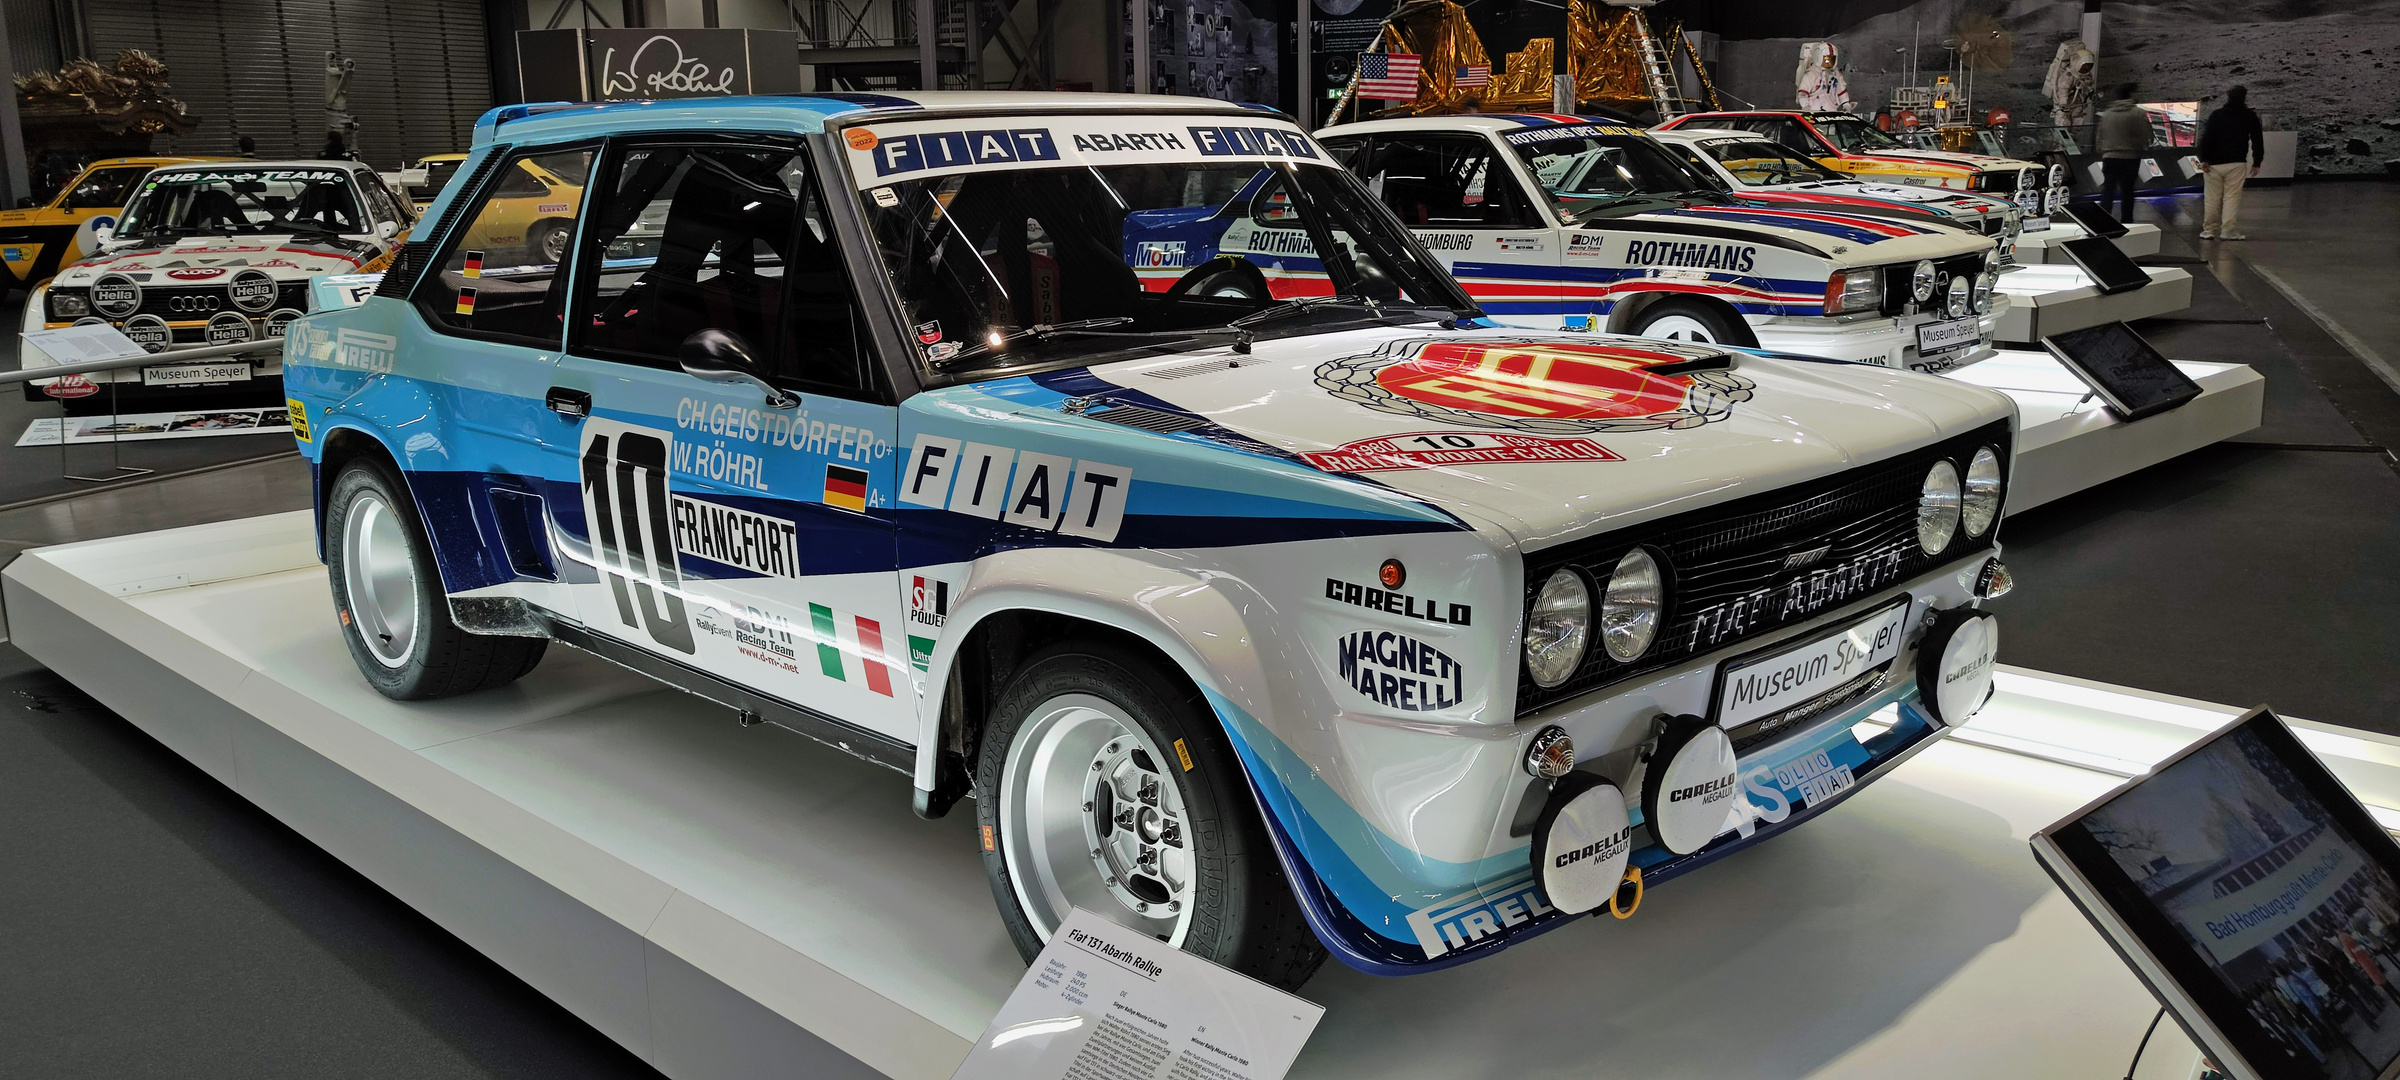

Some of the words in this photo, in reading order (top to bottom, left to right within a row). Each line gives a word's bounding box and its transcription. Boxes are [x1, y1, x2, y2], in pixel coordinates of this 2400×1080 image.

[1505, 127, 1575, 145] ROTHMANS
[1571, 126, 1602, 137] OPEL
[883, 132, 1043, 170] FIAT
[1073, 132, 1187, 152] ABARTH
[1196, 129, 1308, 156] FIAT
[157, 173, 200, 184] HB
[263, 171, 336, 182] TEAM
[1903, 177, 1926, 186] Castrol
[490, 235, 521, 244] BOSCH
[1248, 230, 1315, 254] ROTHMA
[1581, 236, 1604, 246] DMI
[1136, 241, 1185, 267] Mobil
[1625, 240, 1756, 273] ROTHMANS
[98, 291, 132, 301] Hella
[236, 286, 270, 297] Hella
[129, 332, 163, 343] Hella
[213, 328, 246, 340] Hella
[1923, 326, 1956, 343] Museum
[1956, 322, 1976, 340] Speyer
[335, 327, 397, 374] PIRELLI
[149, 368, 200, 380] Museum
[204, 366, 245, 380] Speyer
[1351, 440, 1398, 457] 1980
[1412, 434, 1476, 450] 10
[1494, 435, 1551, 448] 1980
[1427, 442, 1604, 463] MONTE-CARLO
[868, 488, 886, 509] A+
[912, 443, 1119, 529] FIAT
[582, 431, 696, 656] 10
[673, 498, 797, 579] FRANCFORT
[1784, 547, 1831, 569] FIAT
[1325, 577, 1471, 626] CARELLO
[695, 617, 733, 640] RallyEvent
[736, 629, 767, 650] Racing
[769, 639, 795, 658] Team
[1338, 630, 1462, 680] MAGNETI
[1945, 652, 1988, 684] CARELLO
[1338, 666, 1463, 712] MARELLI
[1731, 653, 1829, 711] Museum
[1758, 717, 1778, 732] Auto
[1783, 701, 1821, 722] Manger
[1778, 752, 1829, 787] OLIO
[1670, 772, 1735, 803] CARELLO
[1702, 786, 1734, 806] MEGALUX
[1803, 767, 1852, 803] FIAT
[1555, 825, 1630, 869] CARELLO
[1593, 840, 1630, 866] MEGALUX
[1405, 868, 1555, 961] PIREL
[2205, 912, 2239, 940] Bad
[2229, 897, 2288, 931] Homburg
[2279, 880, 2309, 911] grüßt
[1068, 928, 1087, 943] Fiat
[1086, 937, 1103, 949] 131
[1100, 943, 1134, 963] Abarth
[1131, 957, 1163, 978] Rallye
[1069, 977, 1080, 985] 240
[1074, 970, 1087, 979] 1980
[1064, 984, 1080, 994] 2.000
[1112, 1001, 1125, 1010] Sieger
[1123, 1006, 1136, 1015] Rallye
[1134, 1011, 1149, 1020] Monte
[1146, 1017, 1158, 1025] Carlo
[1156, 1021, 1167, 1029] 1980
[1197, 1025, 1206, 1033] EN
[1190, 1036, 1205, 1046] Winner
[1204, 1043, 1216, 1051] Rally
[1213, 1047, 1228, 1056] Monte
[1226, 1053, 1239, 1061] Carlo
[1237, 1058, 1249, 1066] 1980
